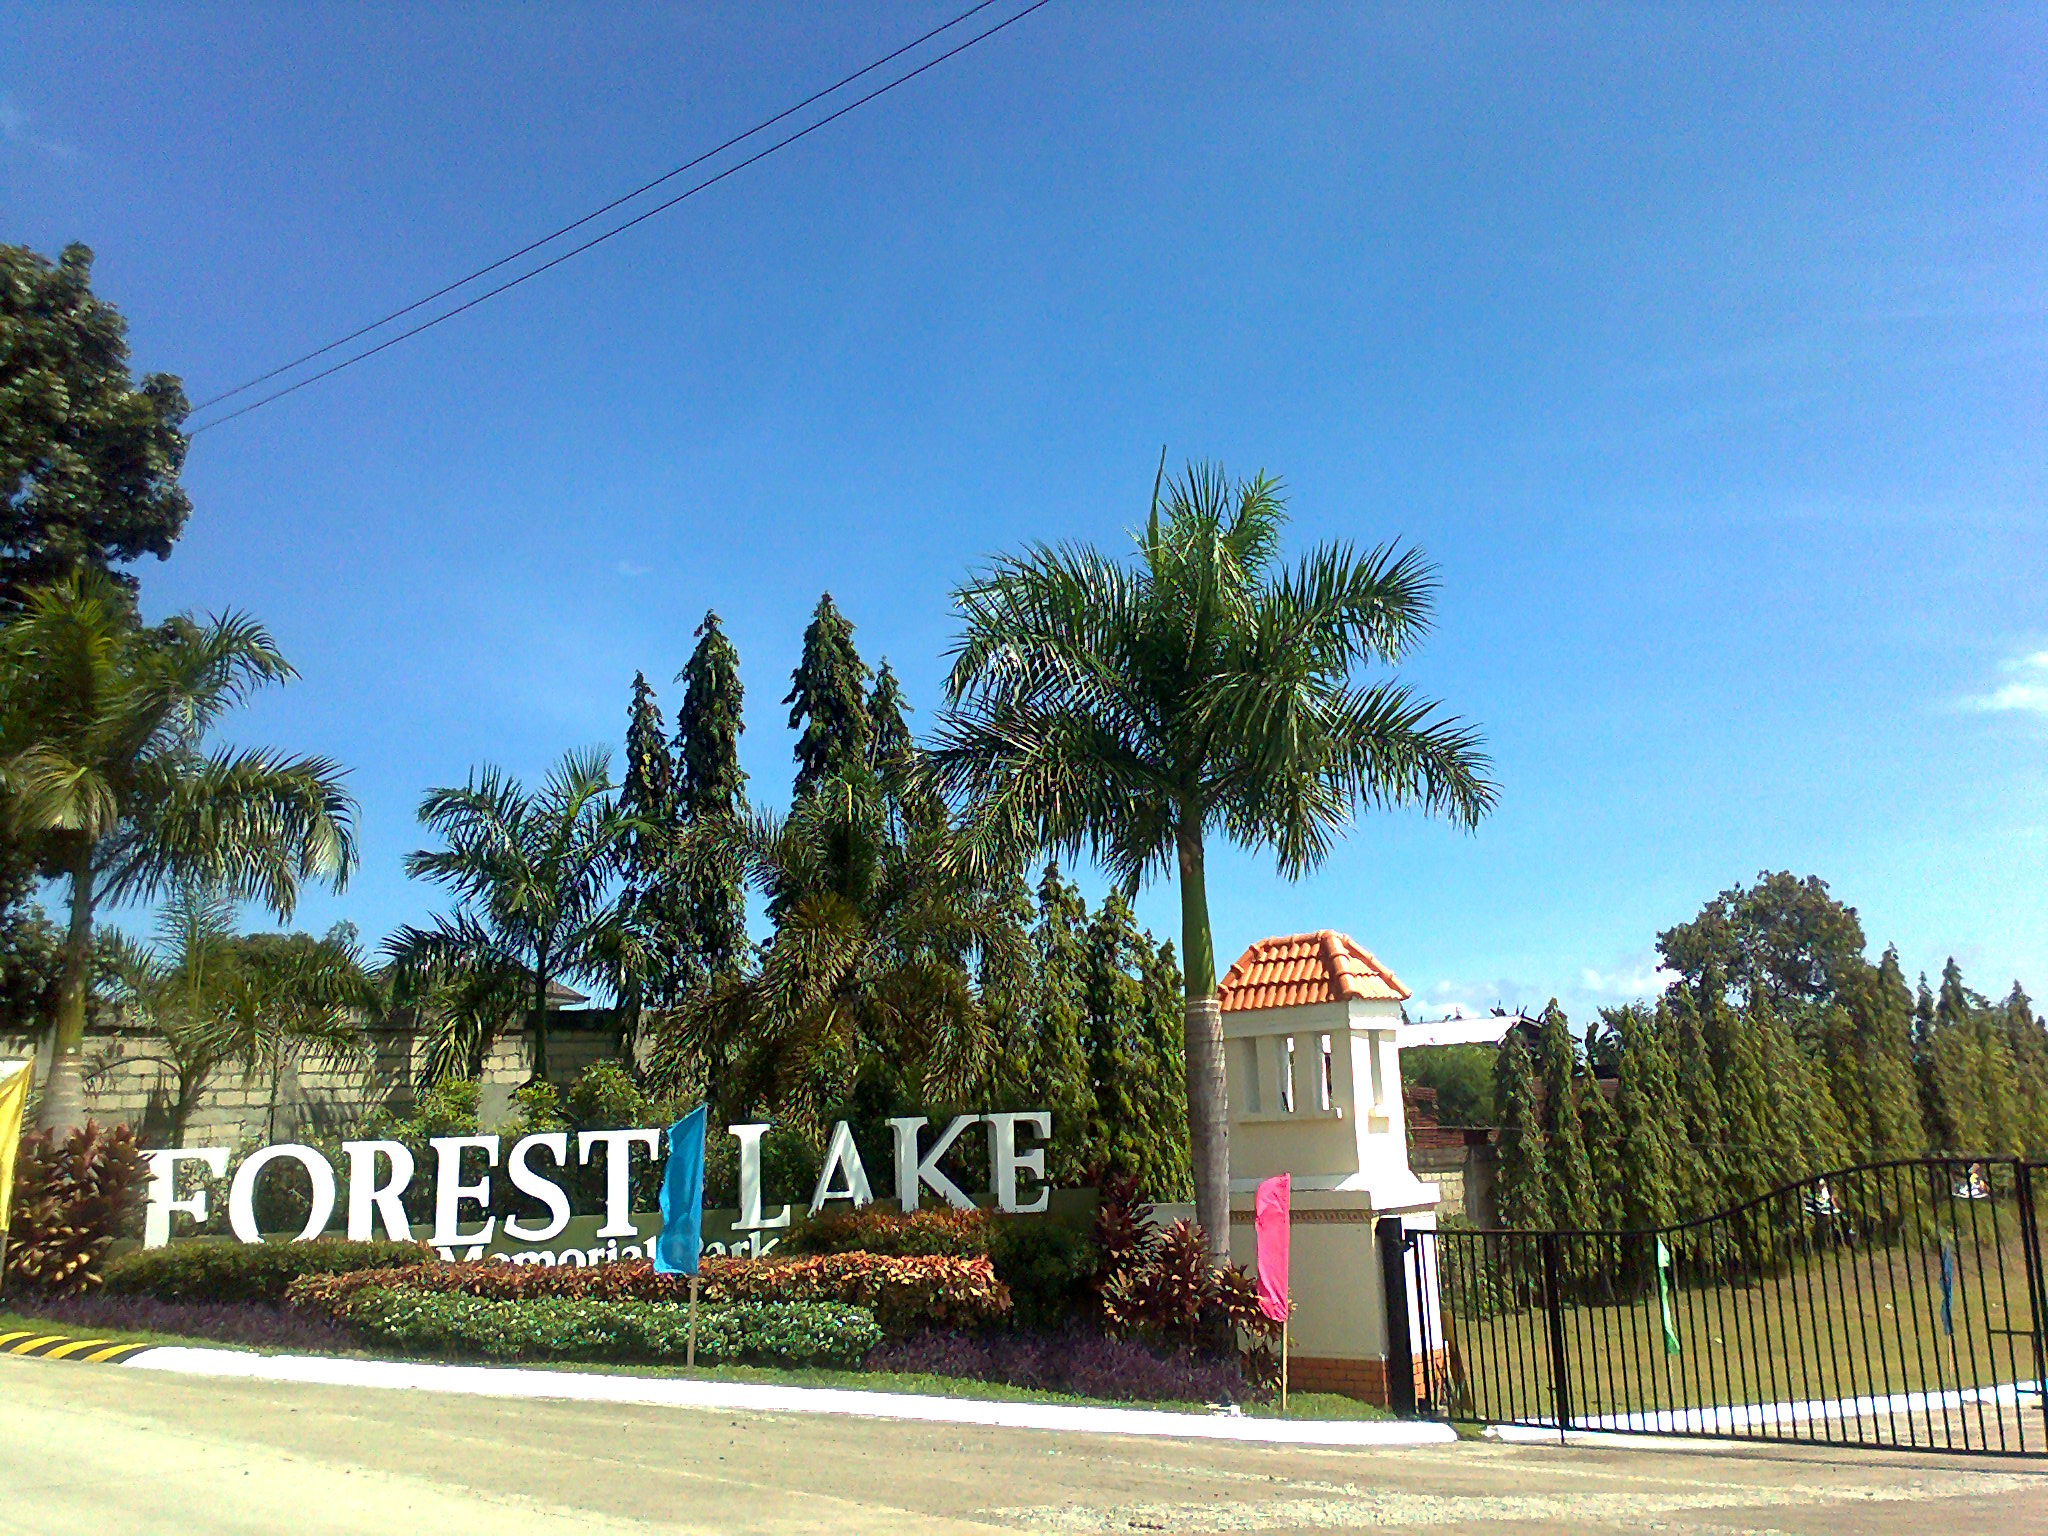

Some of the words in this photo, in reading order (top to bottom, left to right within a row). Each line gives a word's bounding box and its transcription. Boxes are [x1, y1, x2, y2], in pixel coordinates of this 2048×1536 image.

[138, 1128, 660, 1251] FOREST
[728, 1111, 1052, 1231] LAKE
[698, 1230, 780, 1260] ark
